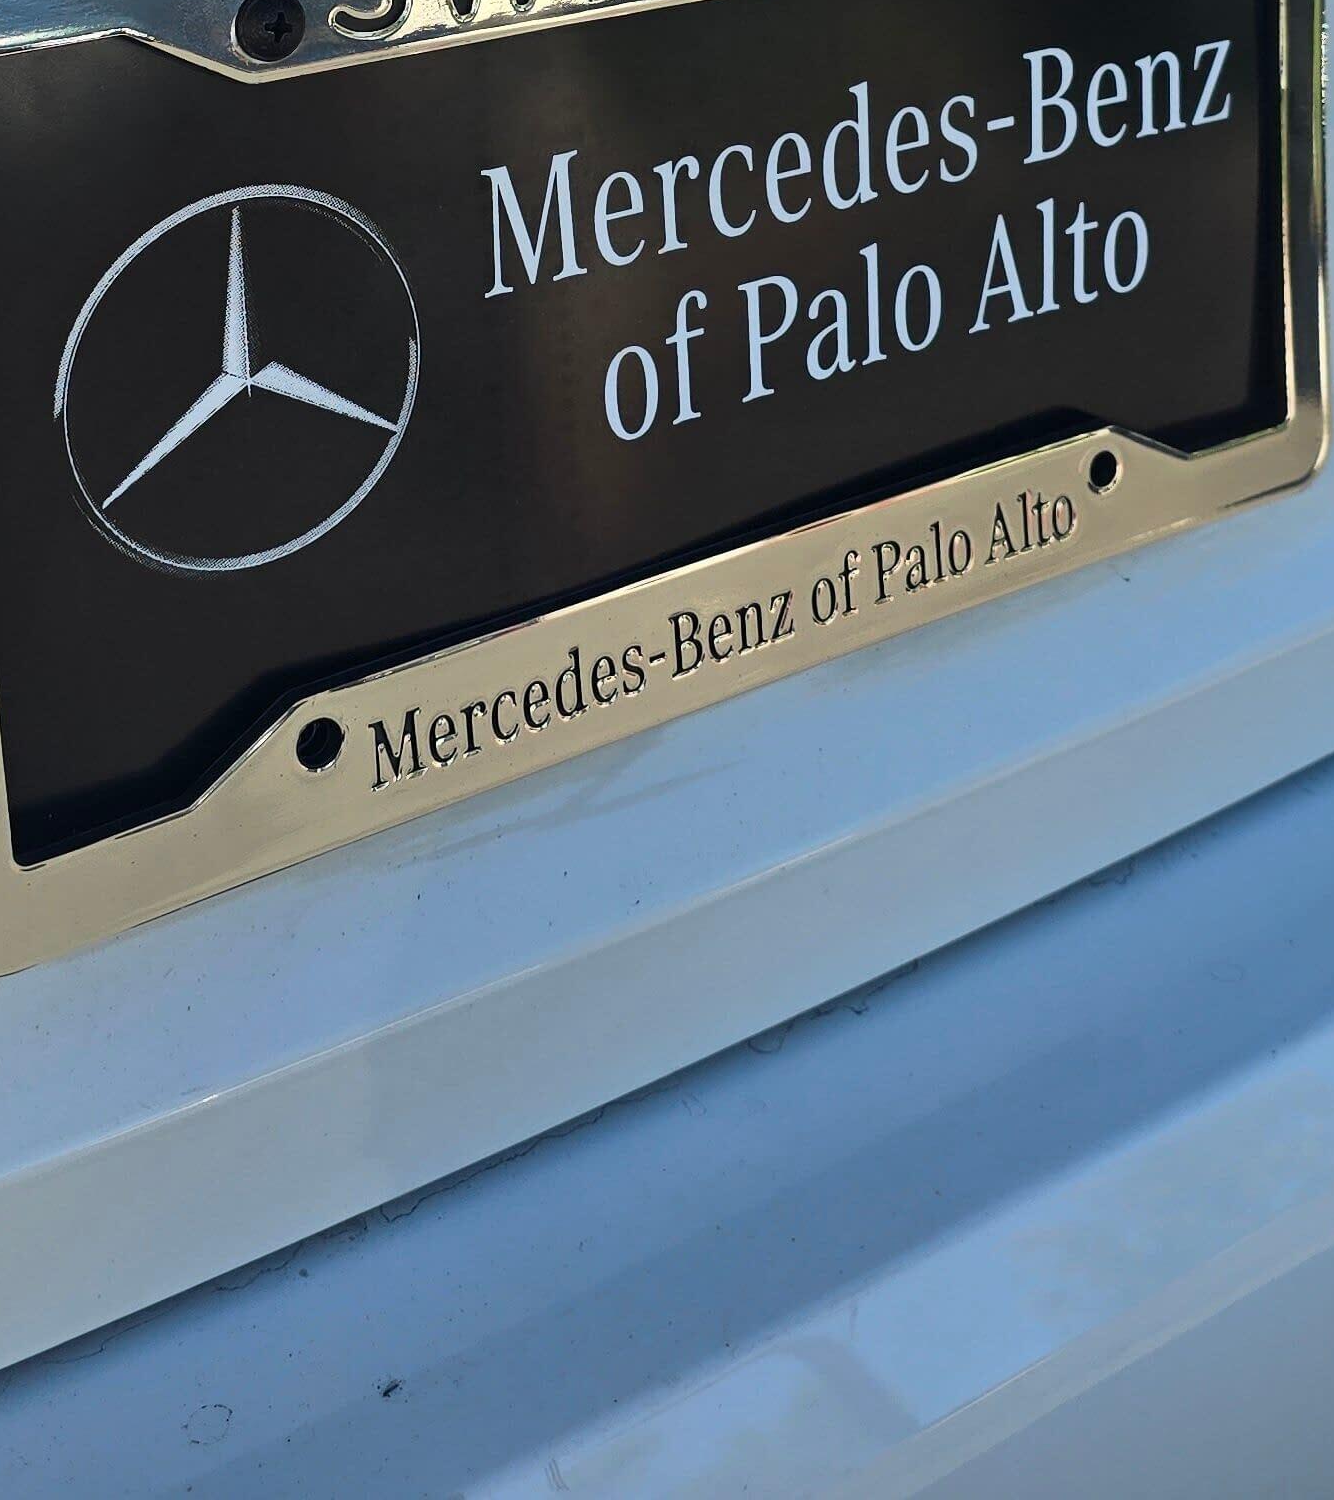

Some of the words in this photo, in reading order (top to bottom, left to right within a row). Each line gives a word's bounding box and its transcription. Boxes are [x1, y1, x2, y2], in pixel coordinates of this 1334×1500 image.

[480, 38, 1232, 299] Mercedes-Benz
[603, 289, 707, 442] of
[737, 243, 943, 404] Palo
[968, 195, 1151, 335] Alto
[369, 589, 795, 792] Mercedes-Benz
[811, 548, 861, 626] of
[870, 520, 973, 604] Palo
[984, 488, 1077, 566] Alto
